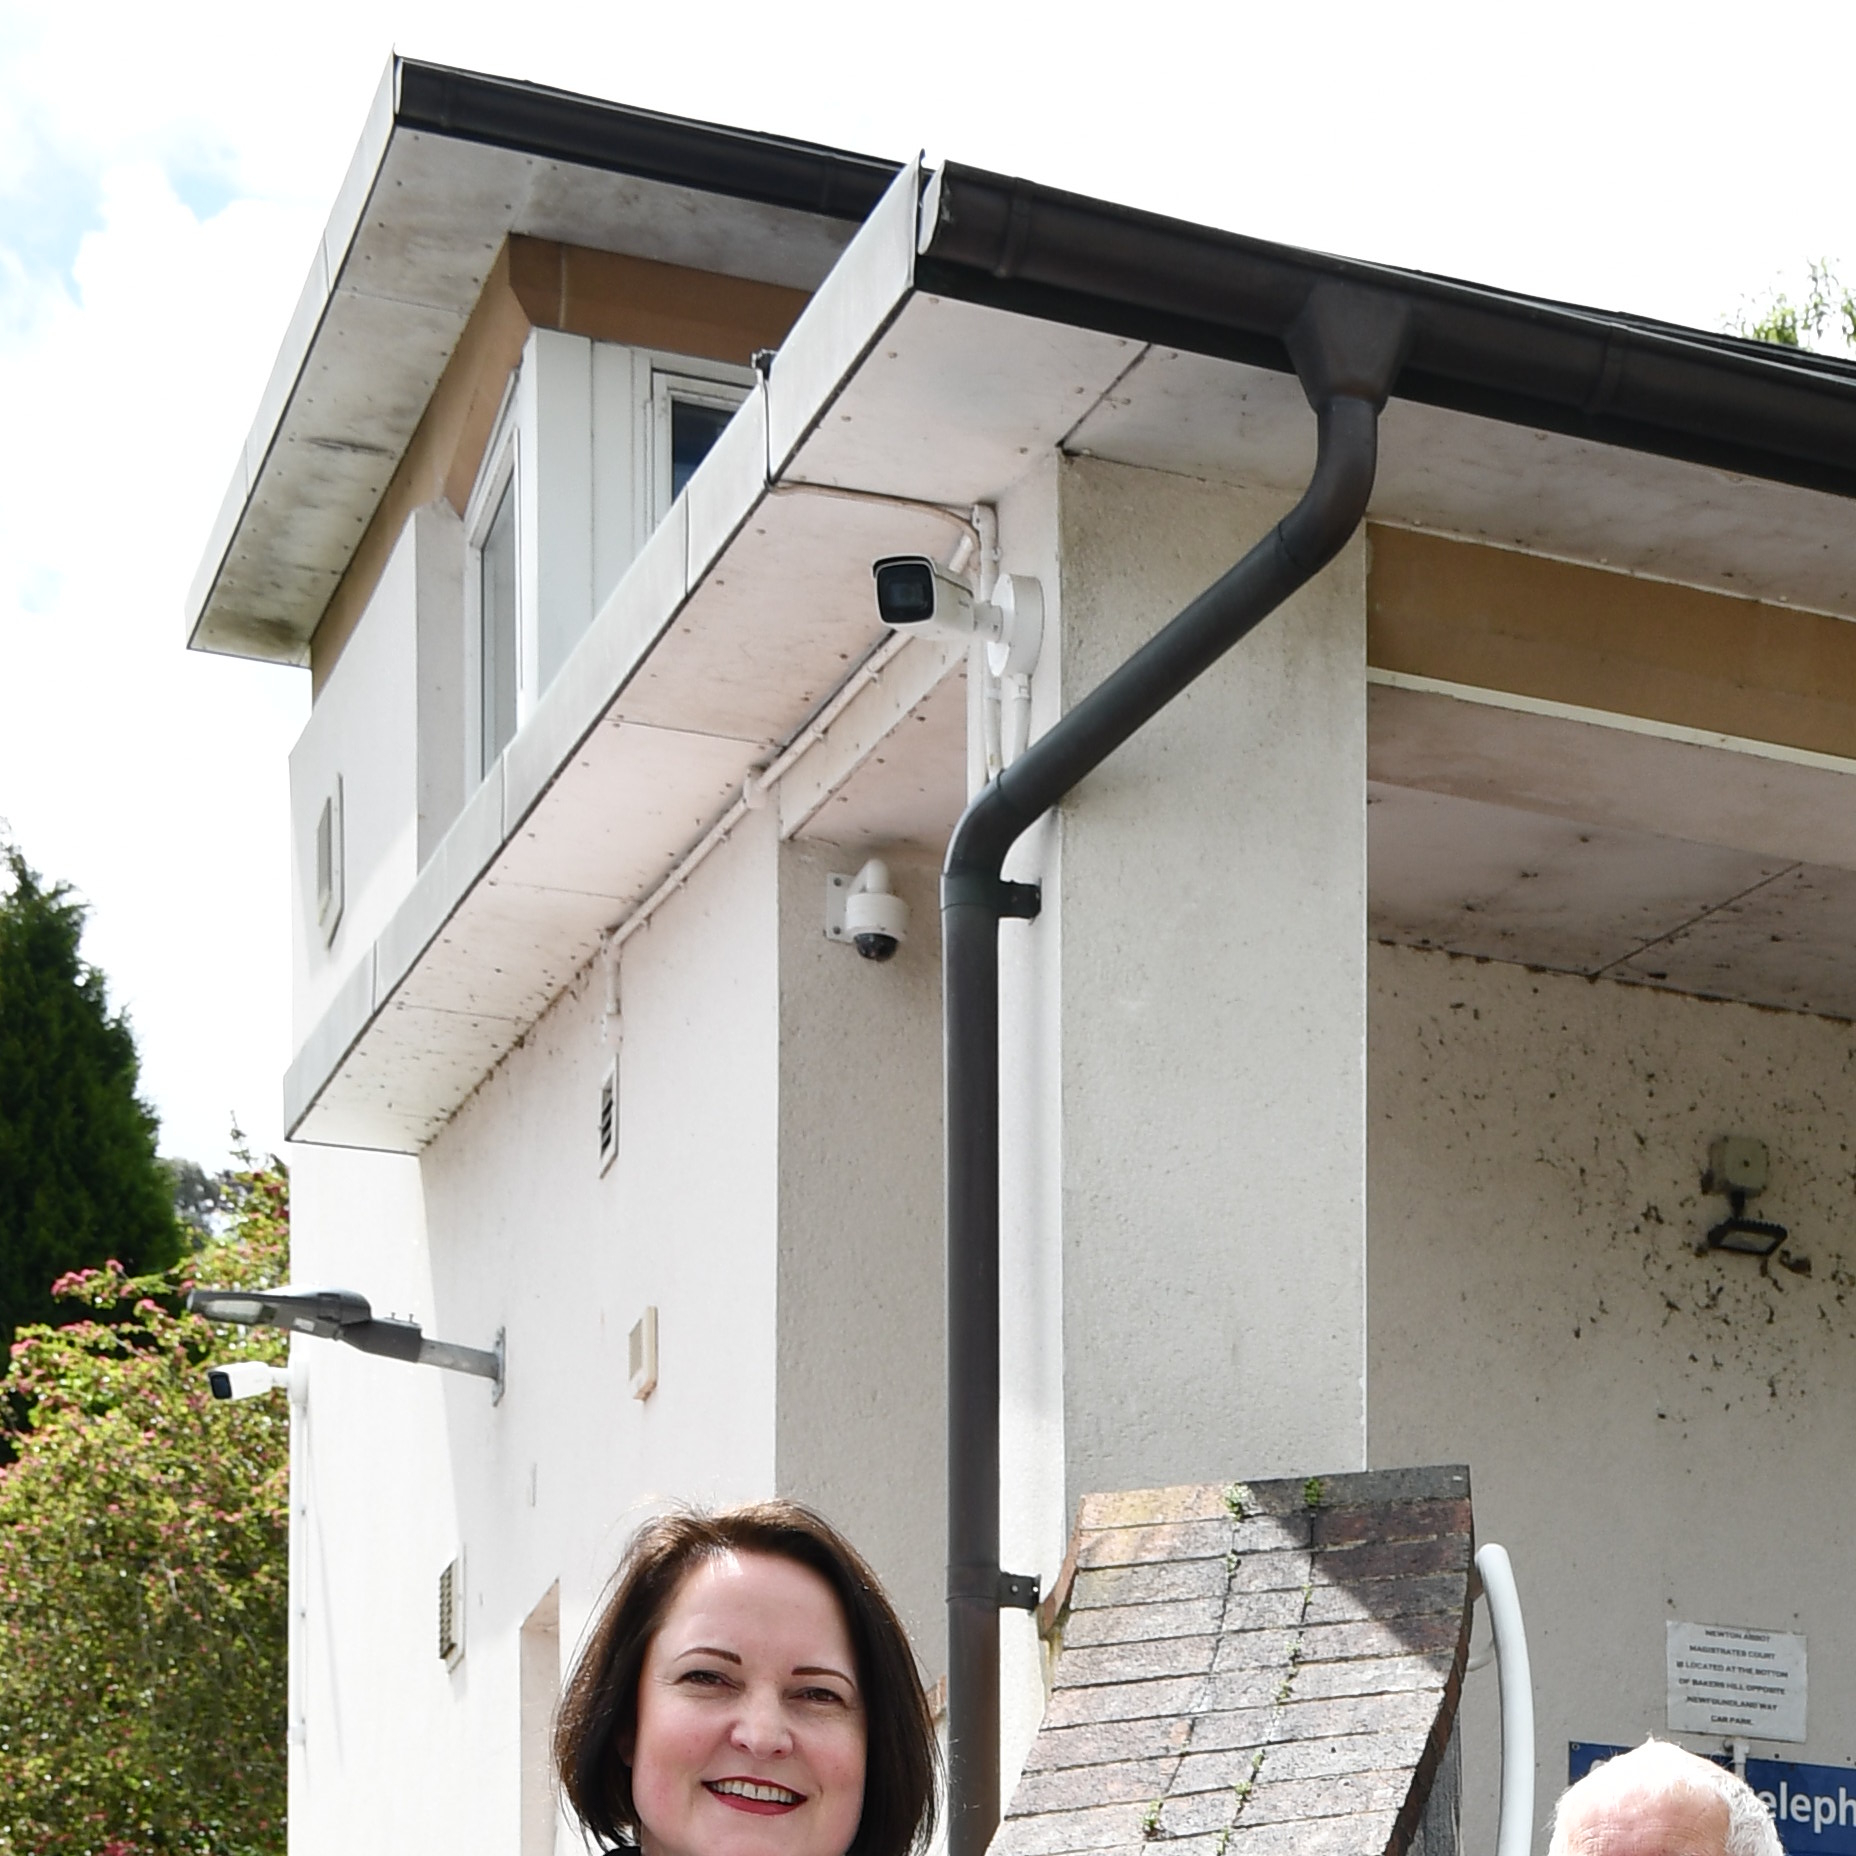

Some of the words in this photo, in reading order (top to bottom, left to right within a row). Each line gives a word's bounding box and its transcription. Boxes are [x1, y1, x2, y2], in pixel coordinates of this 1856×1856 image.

[1705, 1629, 1741, 1640] NEWTON
[1743, 1633, 1770, 1643] ABBOT
[1689, 1645, 1747, 1658] MAGISTRATES
[1748, 1651, 1775, 1660] COURT
[1685, 1662, 1725, 1672] LOCATED
[1725, 1665, 1737, 1673] AT
[1737, 1666, 1753, 1675] THE
[1755, 1668, 1788, 1678] BOTTOM
[1678, 1677, 1690, 1685] OF
[1692, 1679, 1725, 1689] BAKERS
[1726, 1683, 1743, 1691] HILL
[1745, 1685, 1786, 1695] OPPOSITE
[1686, 1696, 1758, 1709] NEWFOUNDLAND
[1759, 1702, 1778, 1711] WAY
[1711, 1715, 1728, 1723] CAR
